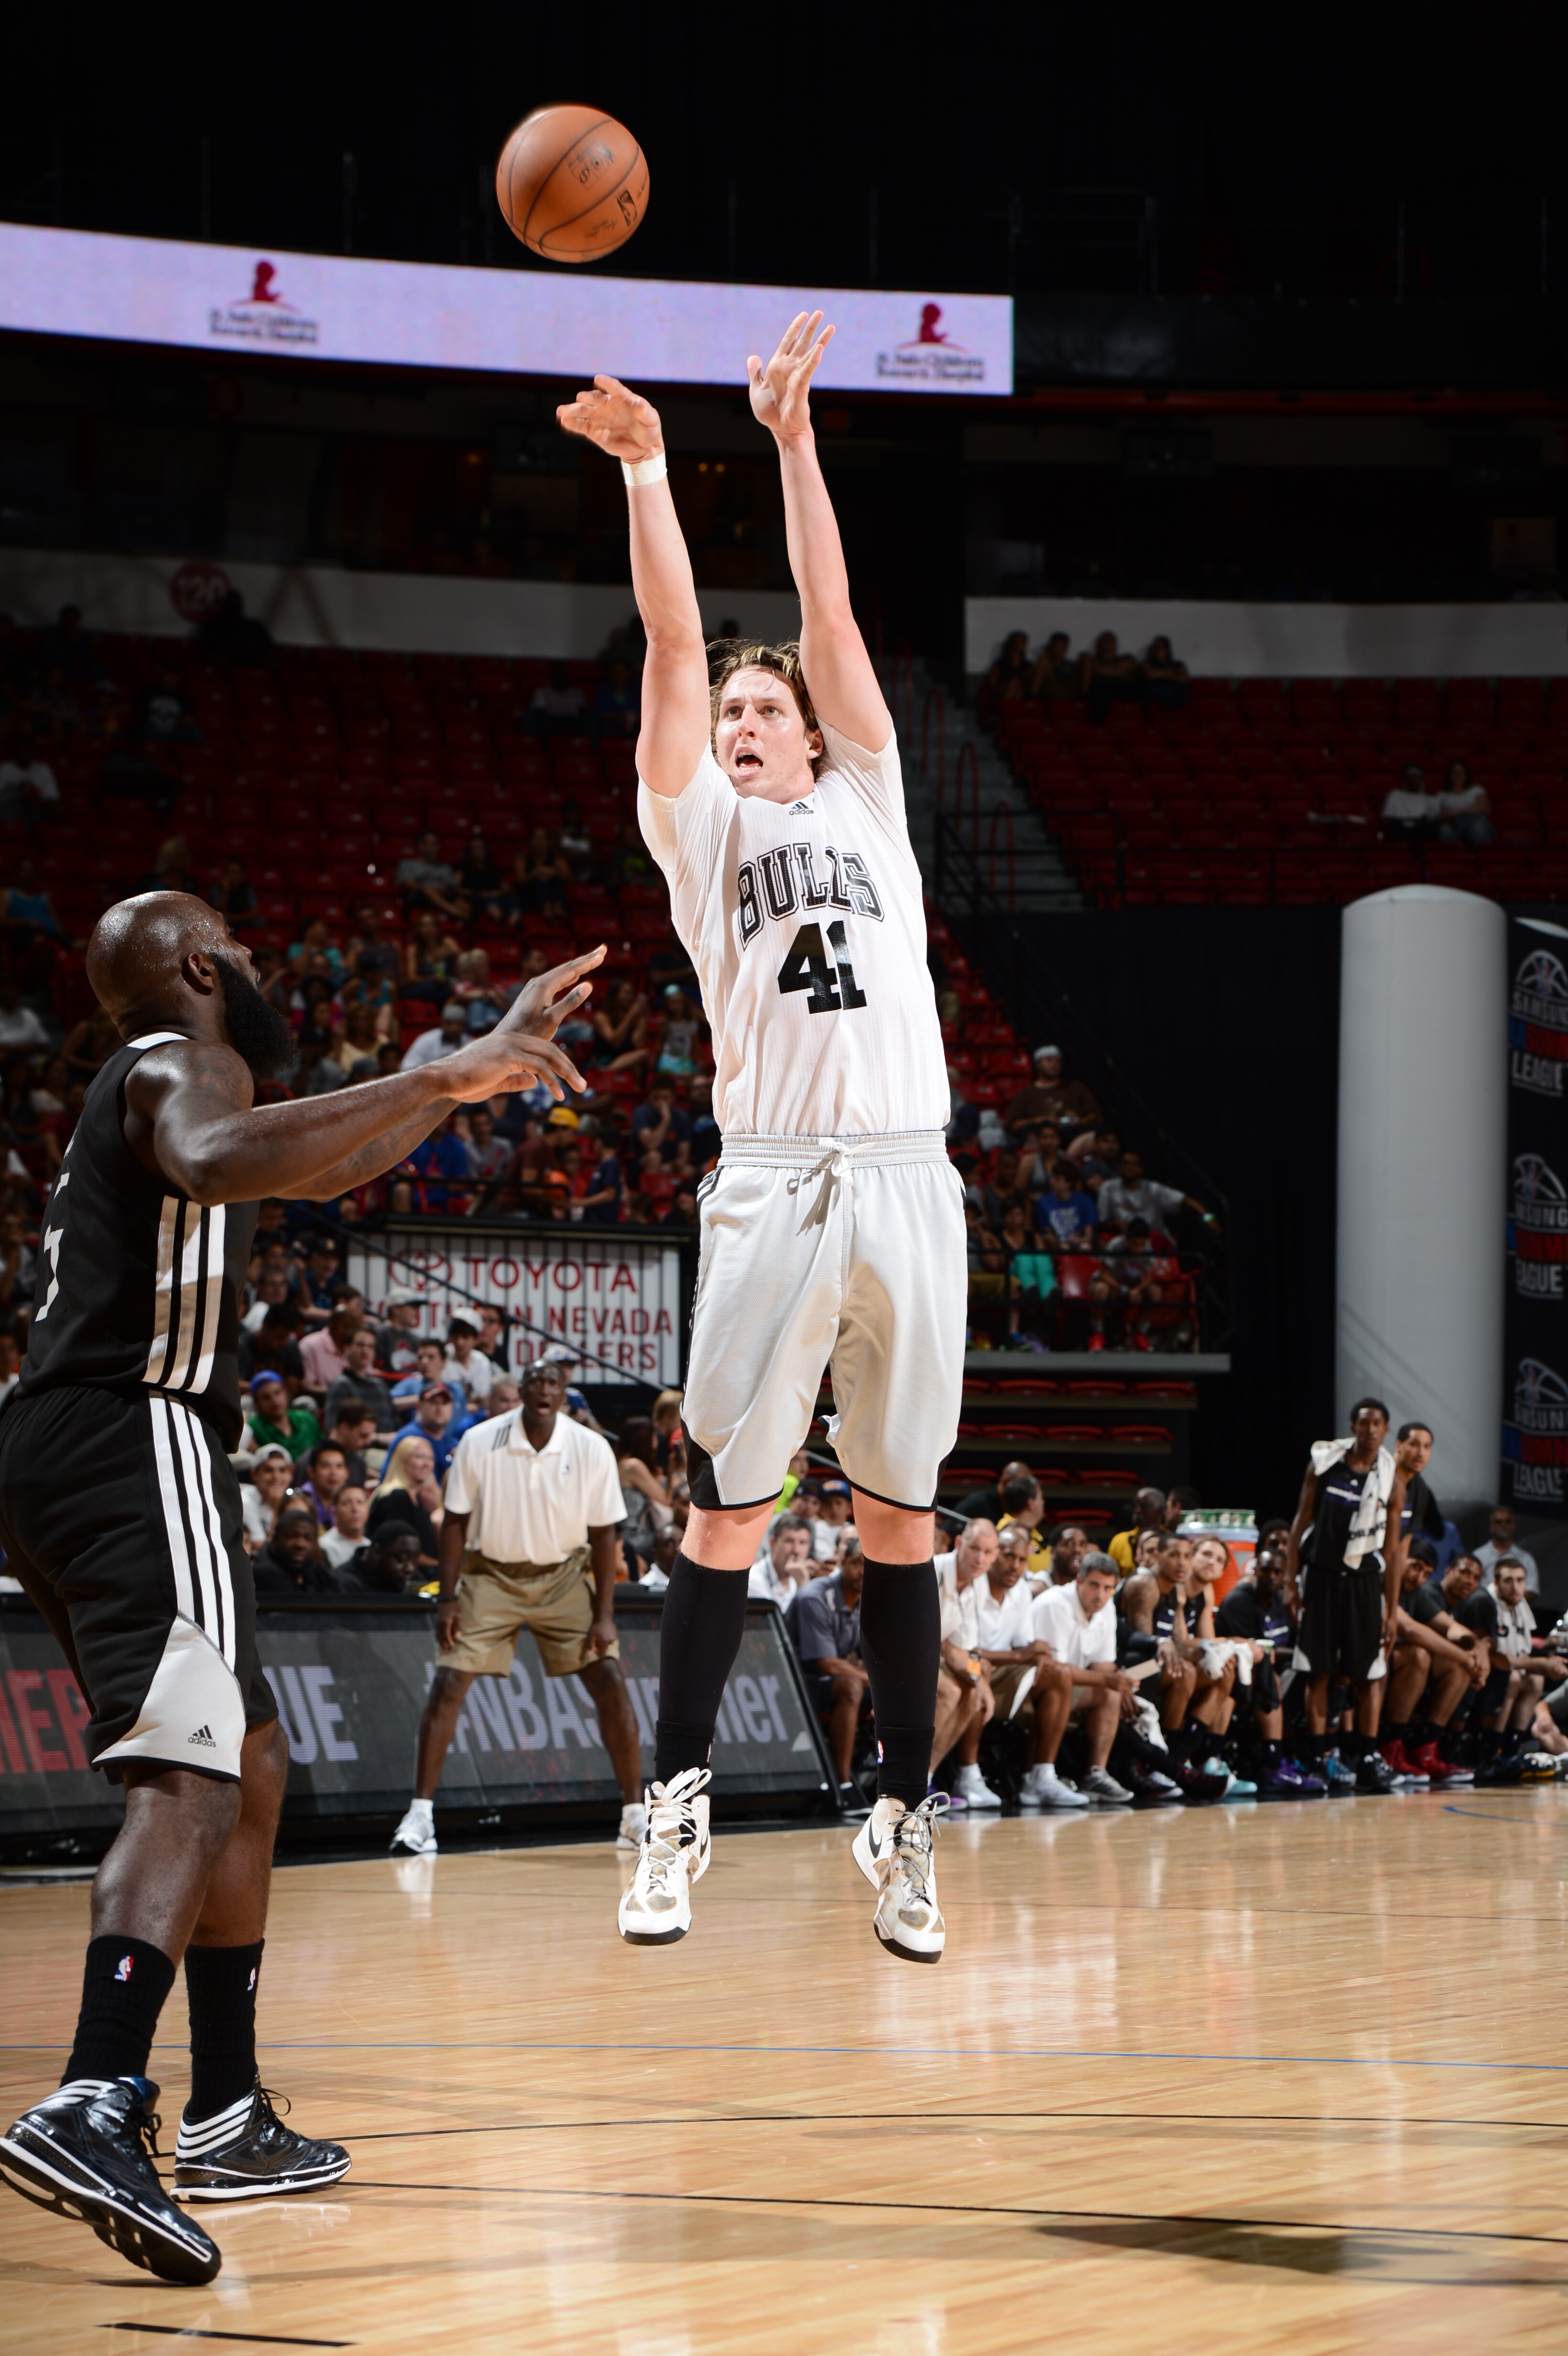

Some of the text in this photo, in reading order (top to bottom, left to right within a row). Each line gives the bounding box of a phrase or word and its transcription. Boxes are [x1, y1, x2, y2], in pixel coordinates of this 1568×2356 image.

[738, 842, 885, 951] BULLS
[777, 920, 868, 1014] 41
[463, 1255, 636, 1293] TOYOTA
[548, 1305, 673, 1335] NEVADA
[516, 1339, 656, 1370] DLERS
[188, 1736, 217, 1748] adidas
